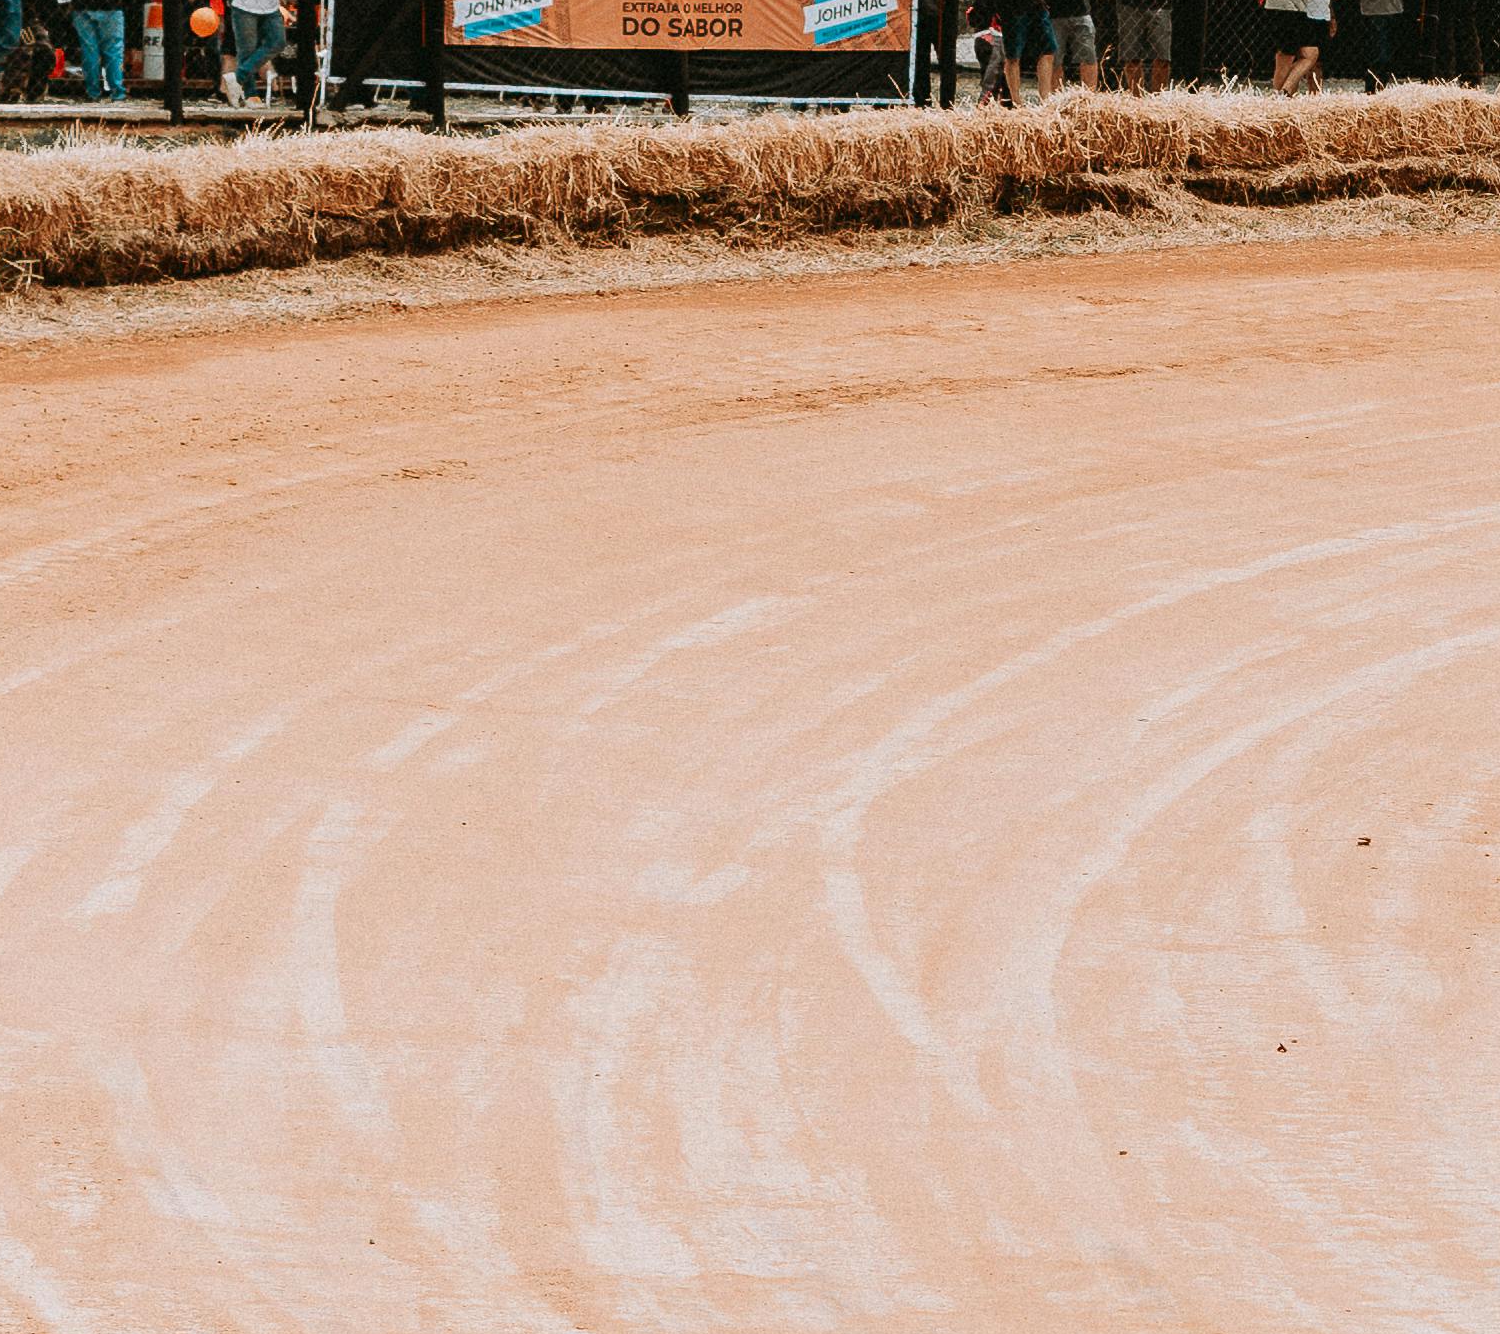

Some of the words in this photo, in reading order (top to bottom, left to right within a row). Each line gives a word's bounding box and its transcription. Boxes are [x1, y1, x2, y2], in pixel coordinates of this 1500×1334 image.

[465, 0, 507, 18] JOHN
[622, 1, 681, 15] EXTRAIA
[693, 2, 743, 14] MELHOR
[814, 3, 852, 26] JOHN
[622, 16, 661, 37] DO
[667, 17, 743, 38] SABOR
